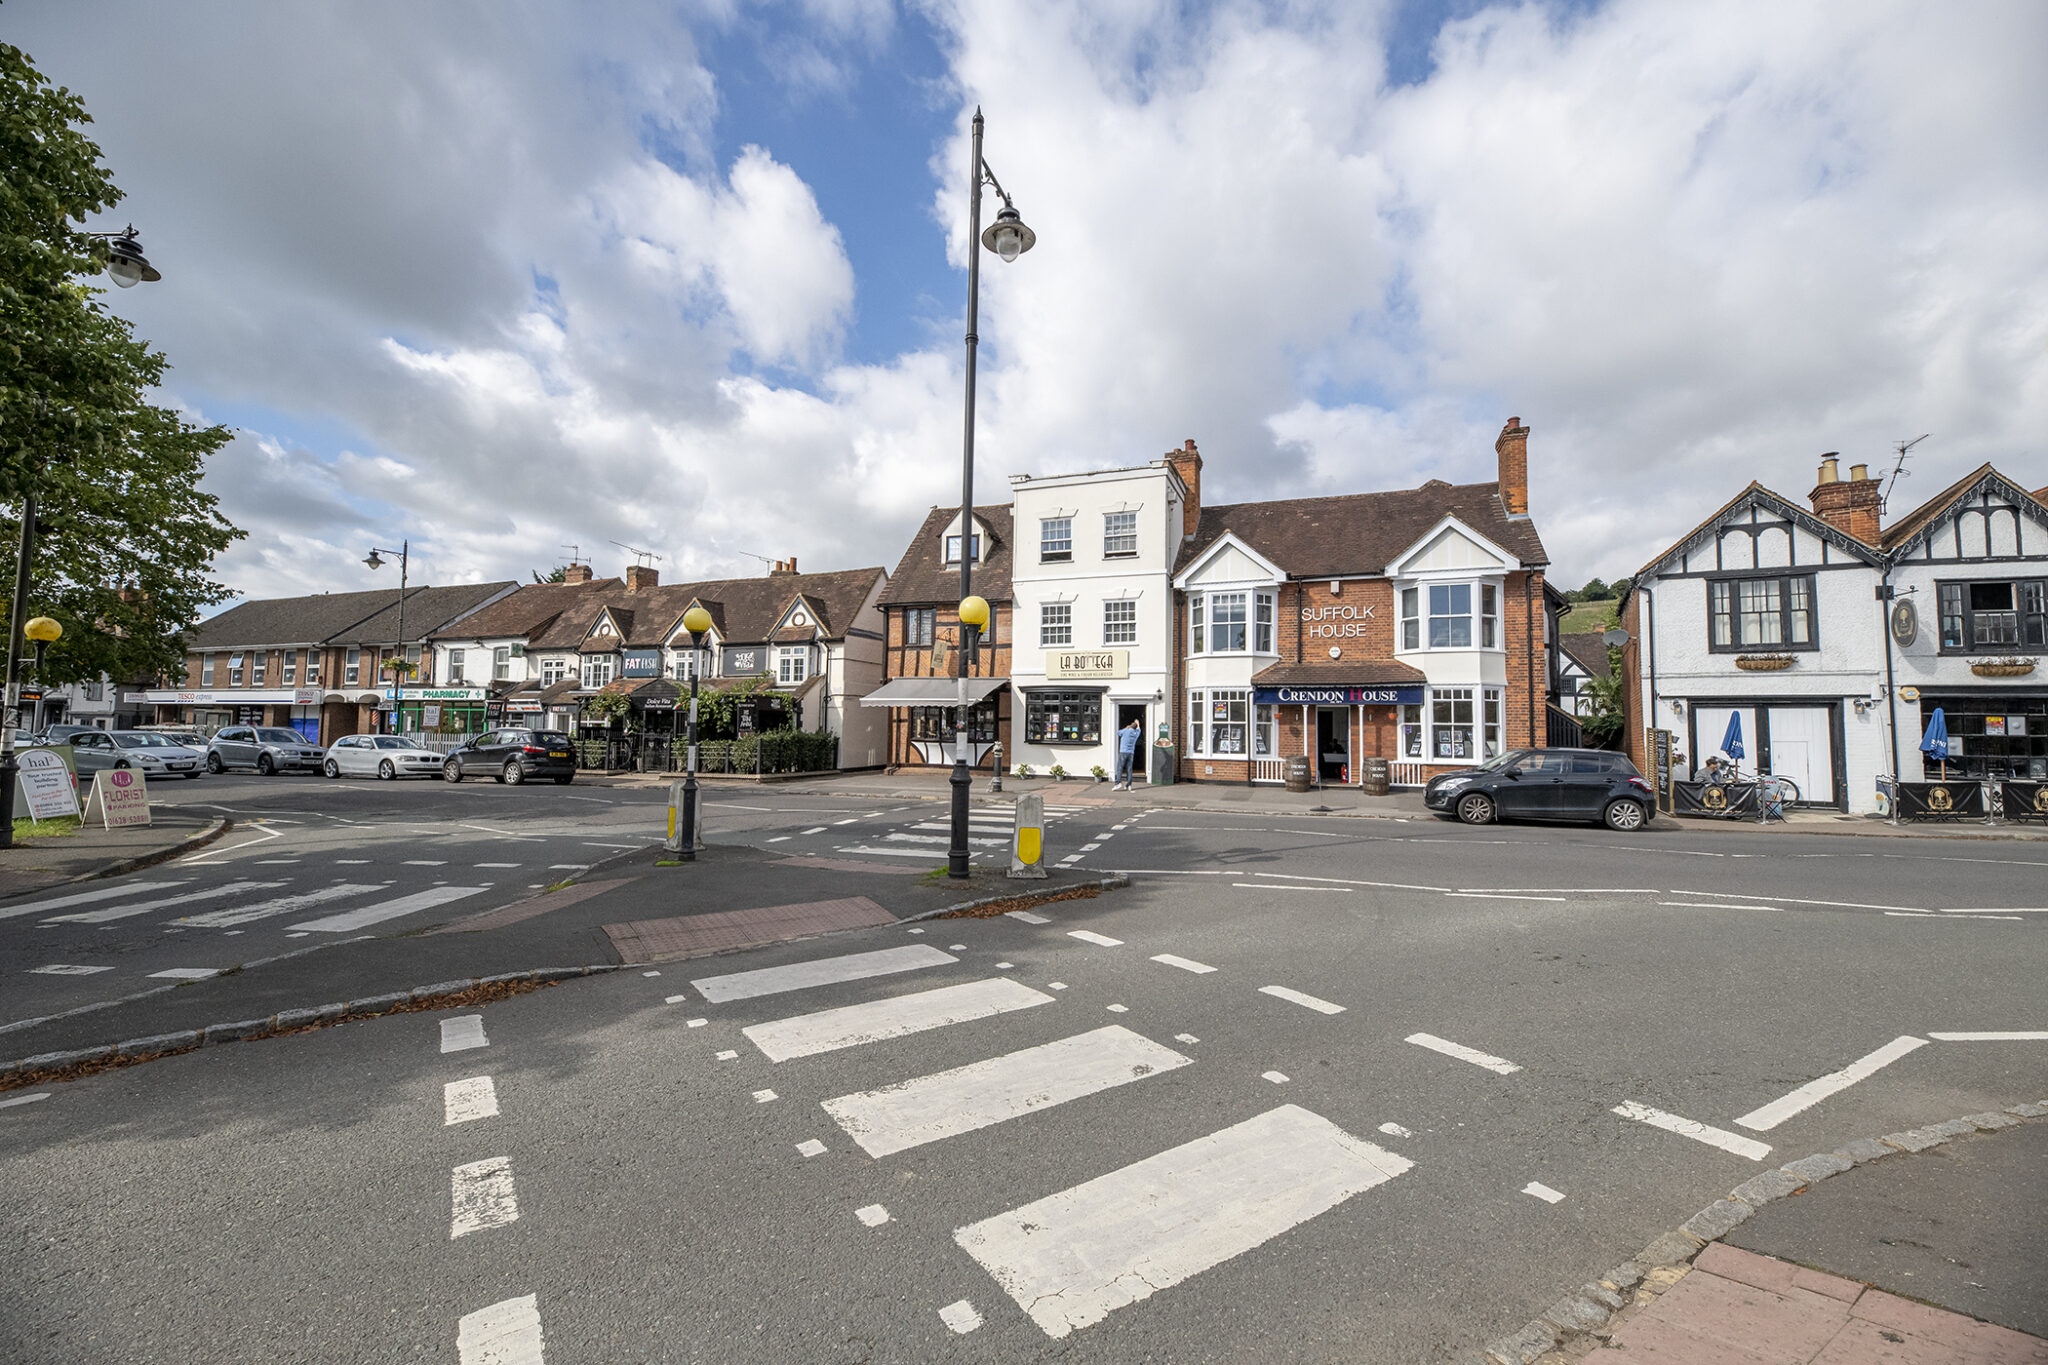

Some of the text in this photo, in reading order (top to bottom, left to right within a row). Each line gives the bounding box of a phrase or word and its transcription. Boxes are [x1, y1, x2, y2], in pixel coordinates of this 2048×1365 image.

[1301, 605, 1375, 621] SUFFOLK
[1310, 623, 1367, 638] HOUSE
[624, 658, 641, 669] FAT
[1060, 655, 1113, 669] LA BOTTEGA
[178, 692, 195, 700] TESCO
[422, 690, 471, 699] PHARMACY
[1278, 687, 1398, 702] CRENDON HOUSE
[103, 789, 145, 802] FLORIST
